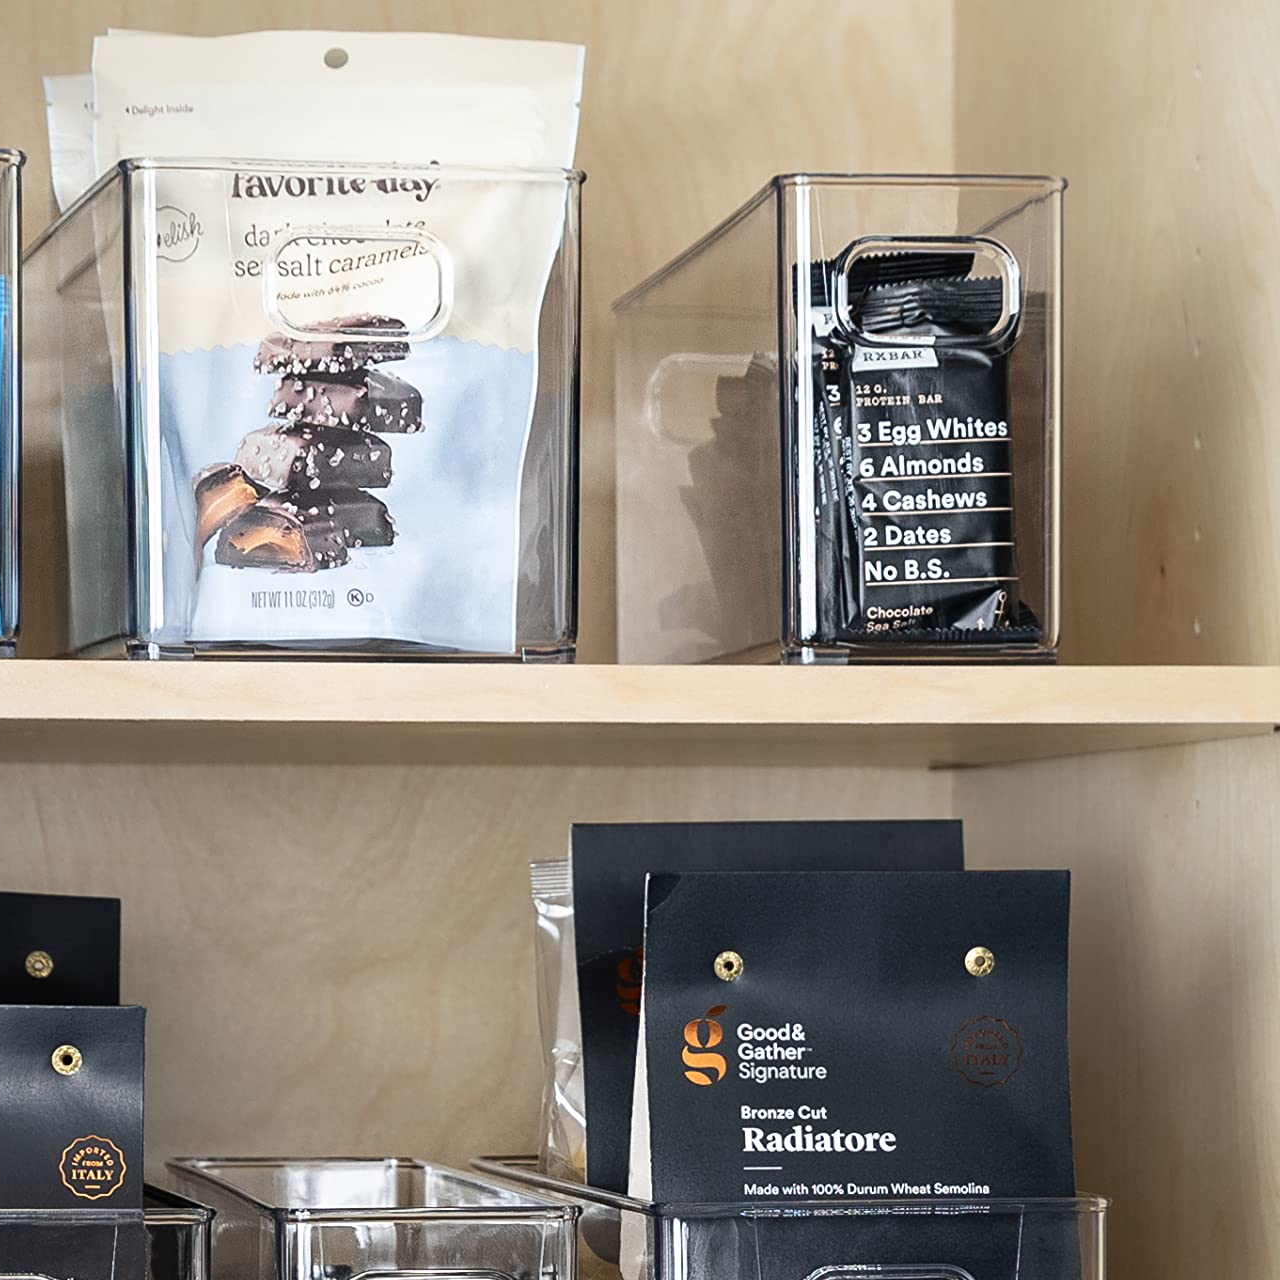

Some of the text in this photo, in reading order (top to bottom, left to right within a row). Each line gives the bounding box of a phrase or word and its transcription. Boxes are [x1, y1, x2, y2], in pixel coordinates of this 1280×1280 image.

[277, 253, 323, 278] salt
[863, 350, 923, 363] RXBAR
[856, 384, 870, 395] 12
[856, 394, 943, 407] PROTEIN BAR
[857, 423, 872, 442] 3
[879, 421, 920, 446] Egg
[926, 417, 1008, 439] Whites
[859, 452, 984, 477] 6 Almonds
[861, 489, 988, 511] 4 Cashews
[863, 527, 878, 546] 2
[885, 525, 952, 545] Dates
[864, 558, 950, 581] No B.S.
[251, 590, 335, 609] NET WT 11 OZ (312g)
[866, 605, 934, 619] Chocolate
[866, 621, 890, 632] Sea
[737, 1023, 806, 1042] Good&
[737, 1043, 807, 1061] Gather
[738, 1062, 828, 1084] Signature
[740, 1105, 828, 1120] Bronze Cut
[742, 1125, 897, 1153] Radiatore
[71, 1169, 114, 1180] ITALY
[744, 1182, 990, 1196] Made with 100% Durum Wheat Semolina
